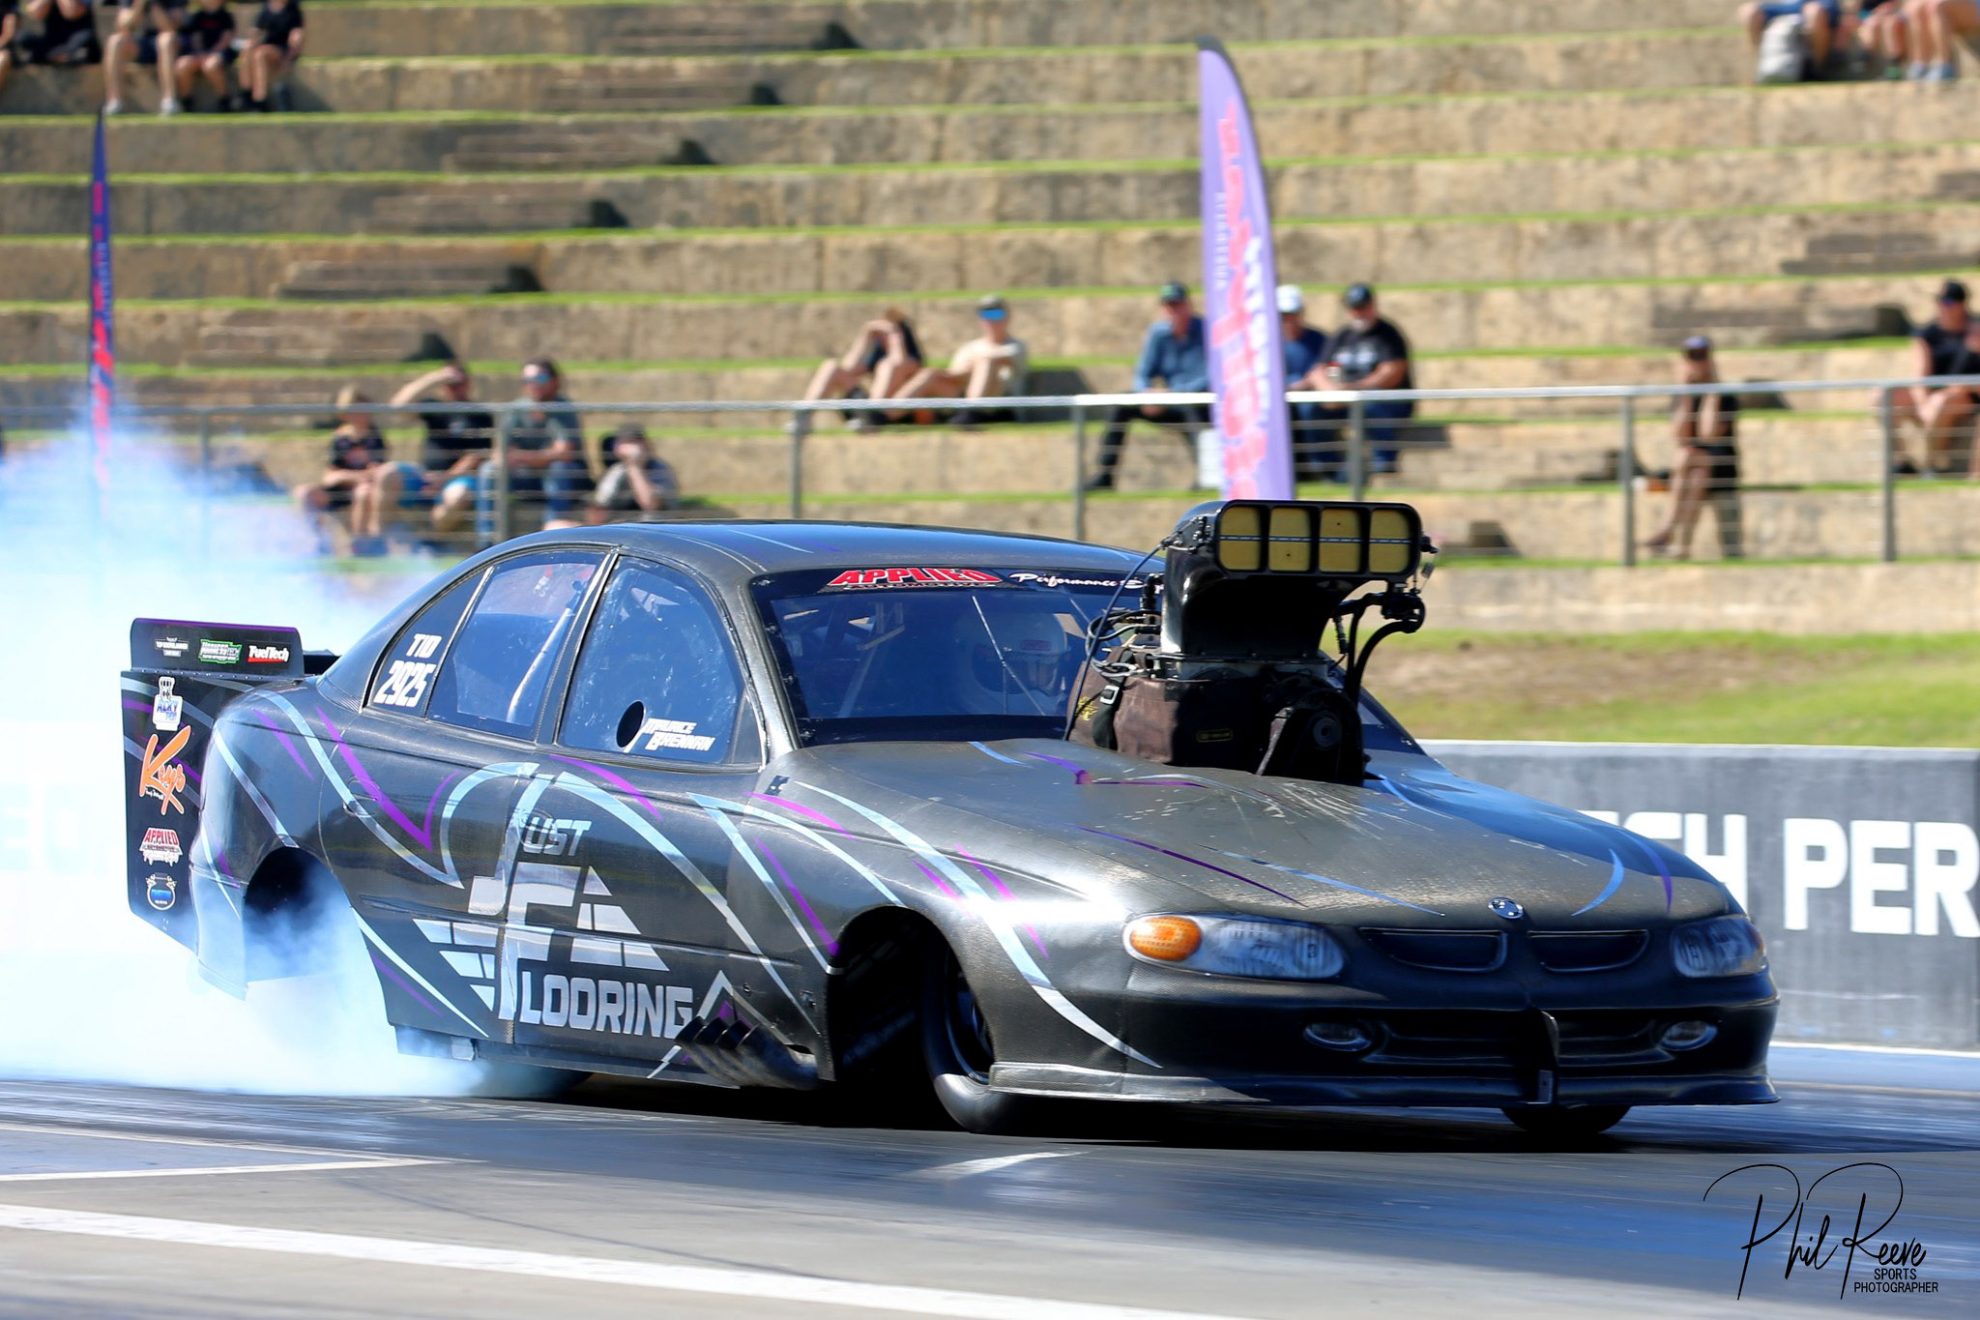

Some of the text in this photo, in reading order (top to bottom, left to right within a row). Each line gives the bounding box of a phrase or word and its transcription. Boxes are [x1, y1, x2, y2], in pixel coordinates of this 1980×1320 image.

[827, 567, 1003, 586] APPLIED
[247, 645, 290, 662] FuelTech
[143, 829, 179, 846] APPLIED
[1784, 818, 1980, 938] PER
